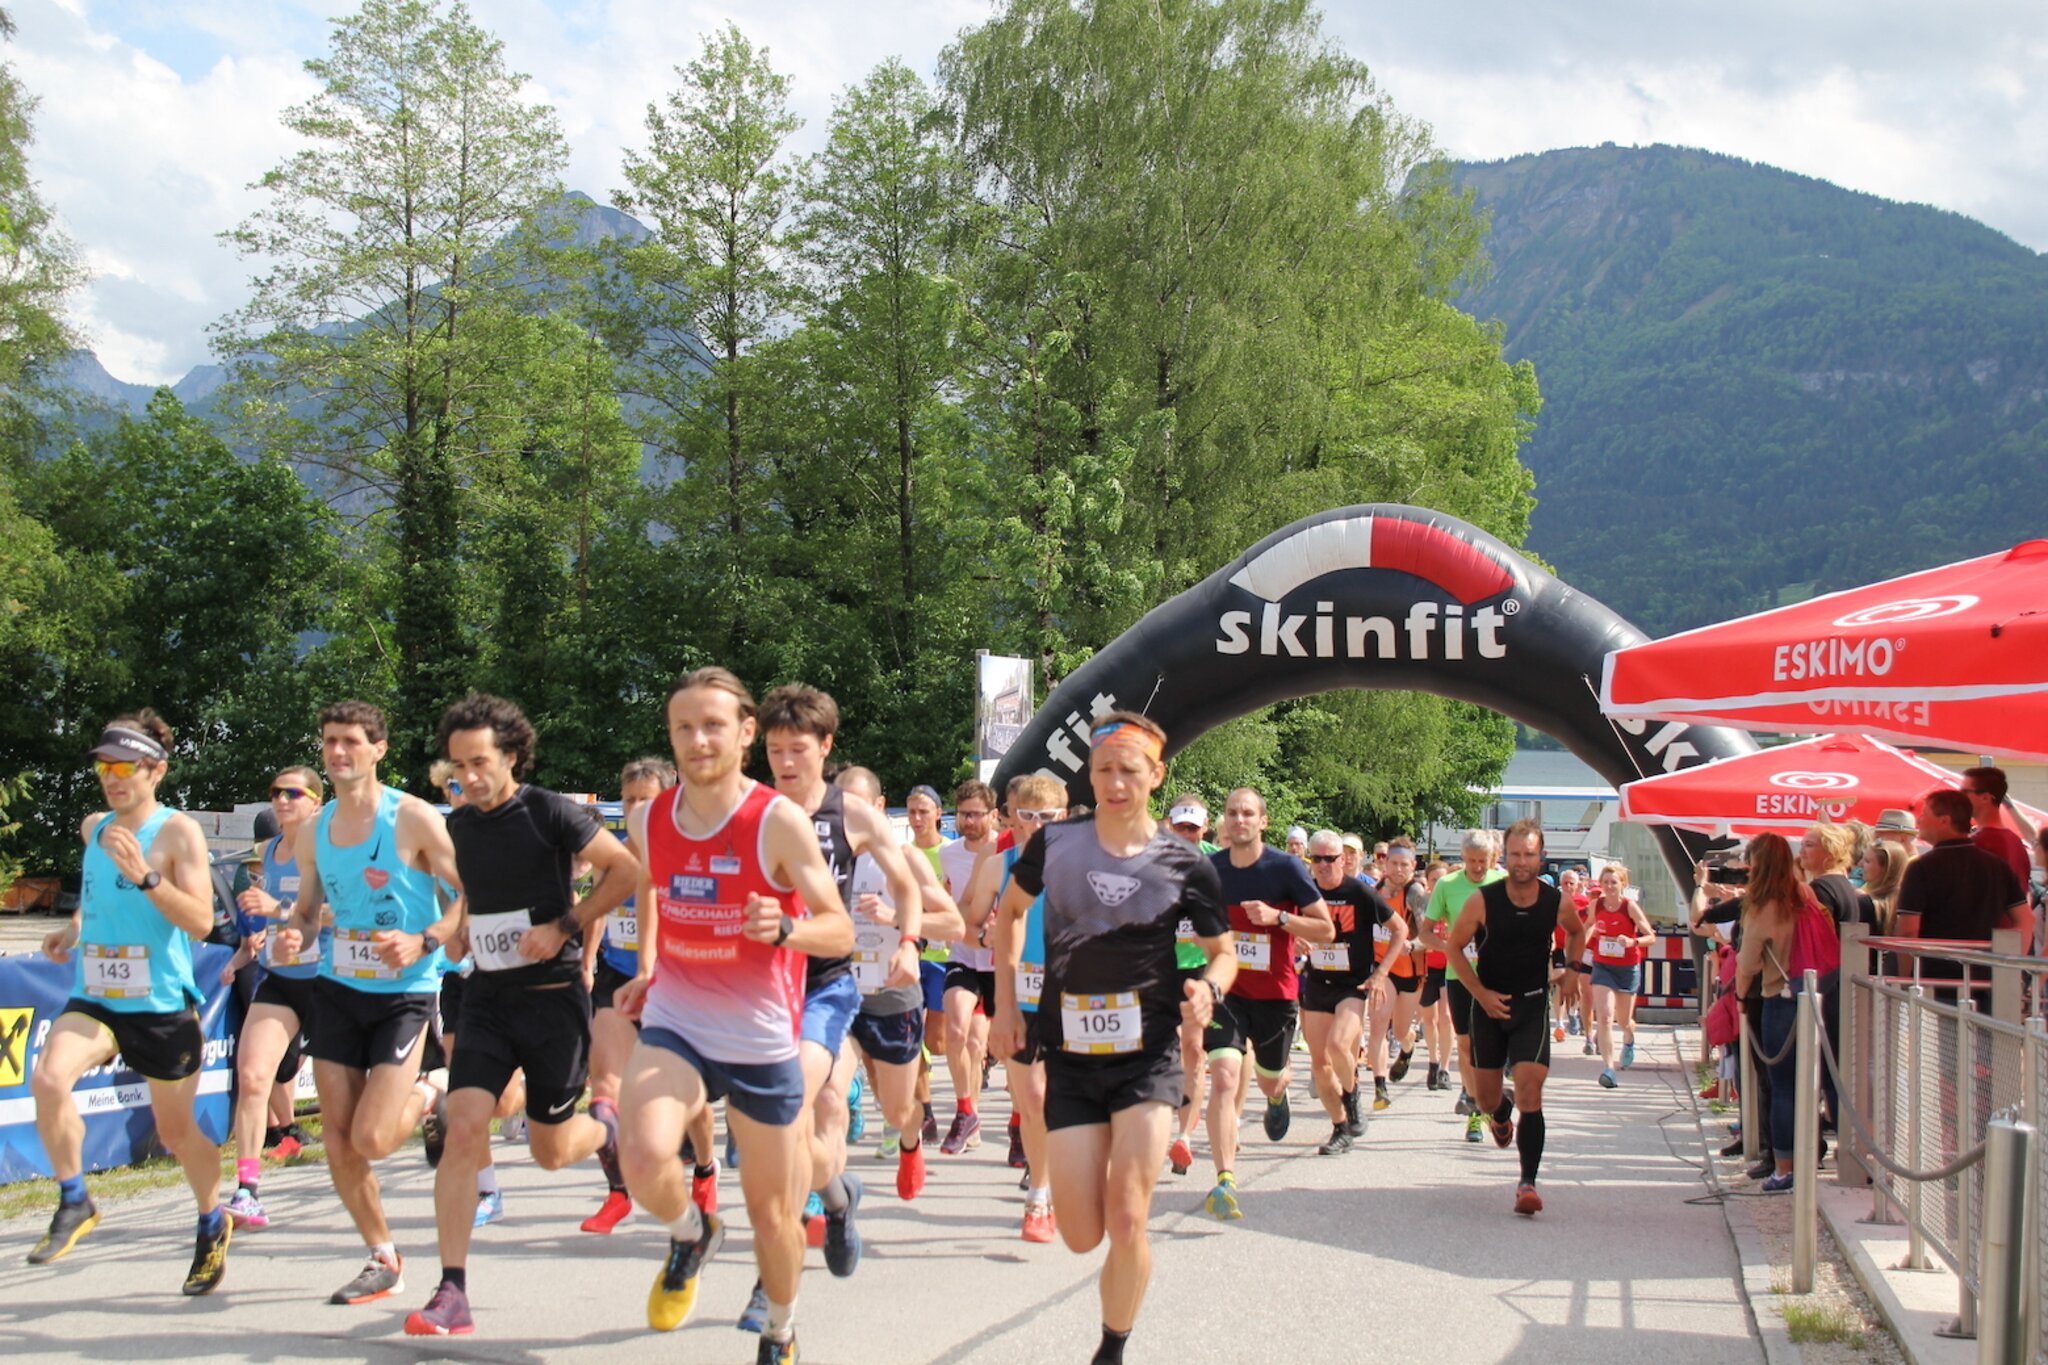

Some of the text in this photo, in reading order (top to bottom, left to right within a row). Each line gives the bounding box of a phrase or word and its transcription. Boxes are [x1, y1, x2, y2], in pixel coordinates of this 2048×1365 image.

[1234, 943, 1257, 957] 164
[1322, 951, 1335, 961] 70
[98, 962, 131, 980] 143
[1079, 1013, 1121, 1033] 105
[88, 1087, 144, 1109] Meine Bank
